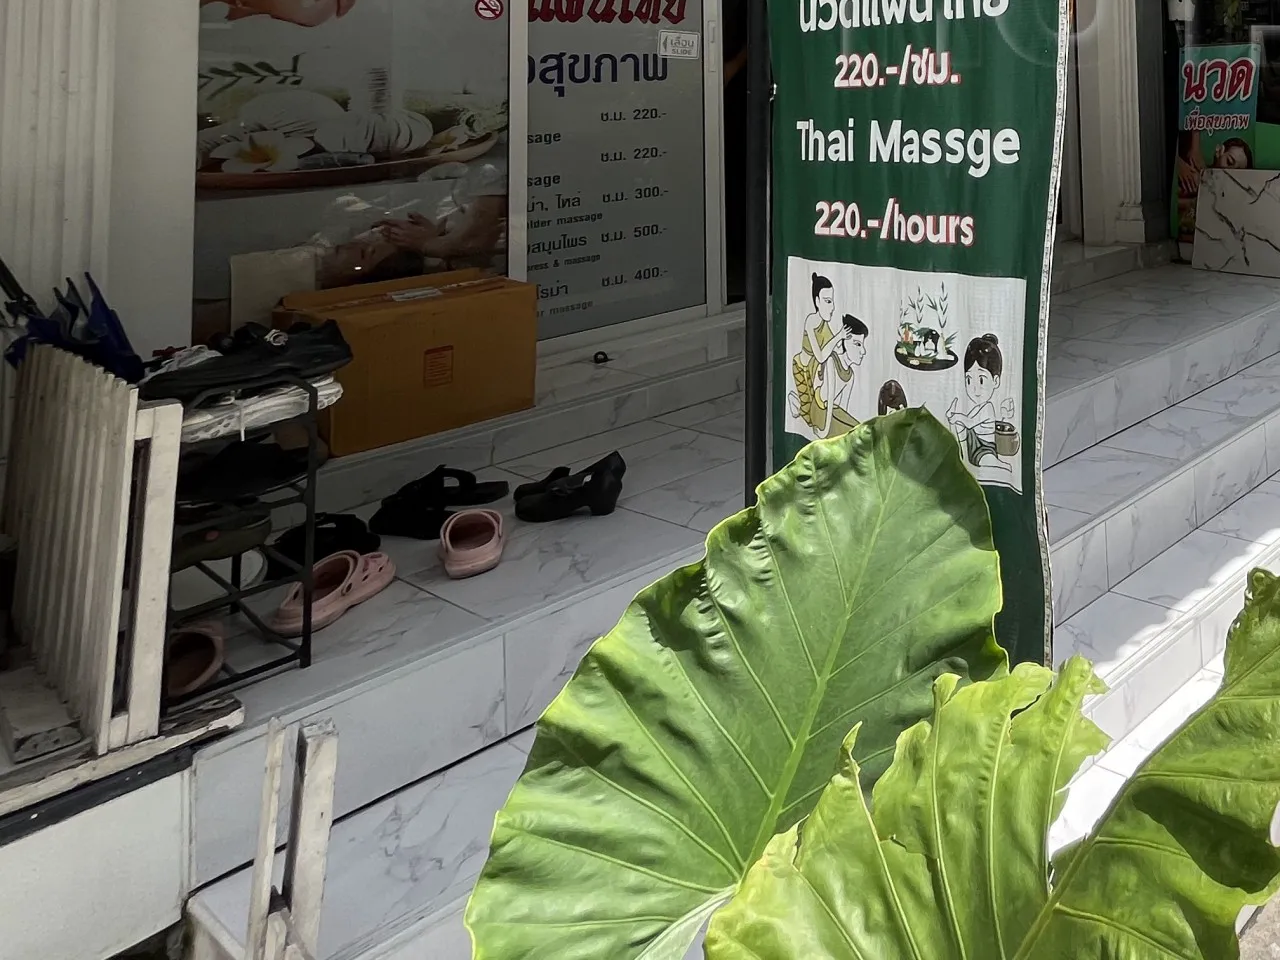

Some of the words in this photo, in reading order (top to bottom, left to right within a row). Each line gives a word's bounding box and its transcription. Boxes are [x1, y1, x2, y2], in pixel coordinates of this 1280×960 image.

[671, 48, 692, 56] SLIDE
[1182, 57, 1256, 102] นวด
[633, 108, 667, 120] 220.-
[1184, 106, 1251, 137] เพื่อสุขภาพ
[633, 147, 667, 160] 220.-
[796, 118, 855, 162] Thai
[869, 119, 1021, 178] Massge
[634, 186, 669, 199] 300.-
[556, 212, 603, 226] massage
[814, 197, 975, 248] 220.-/hours
[633, 224, 667, 238] 500.-
[553, 259, 560, 268] &
[564, 253, 601, 266] massage
[634, 267, 668, 281] 400.-
[549, 300, 594, 315] massage
